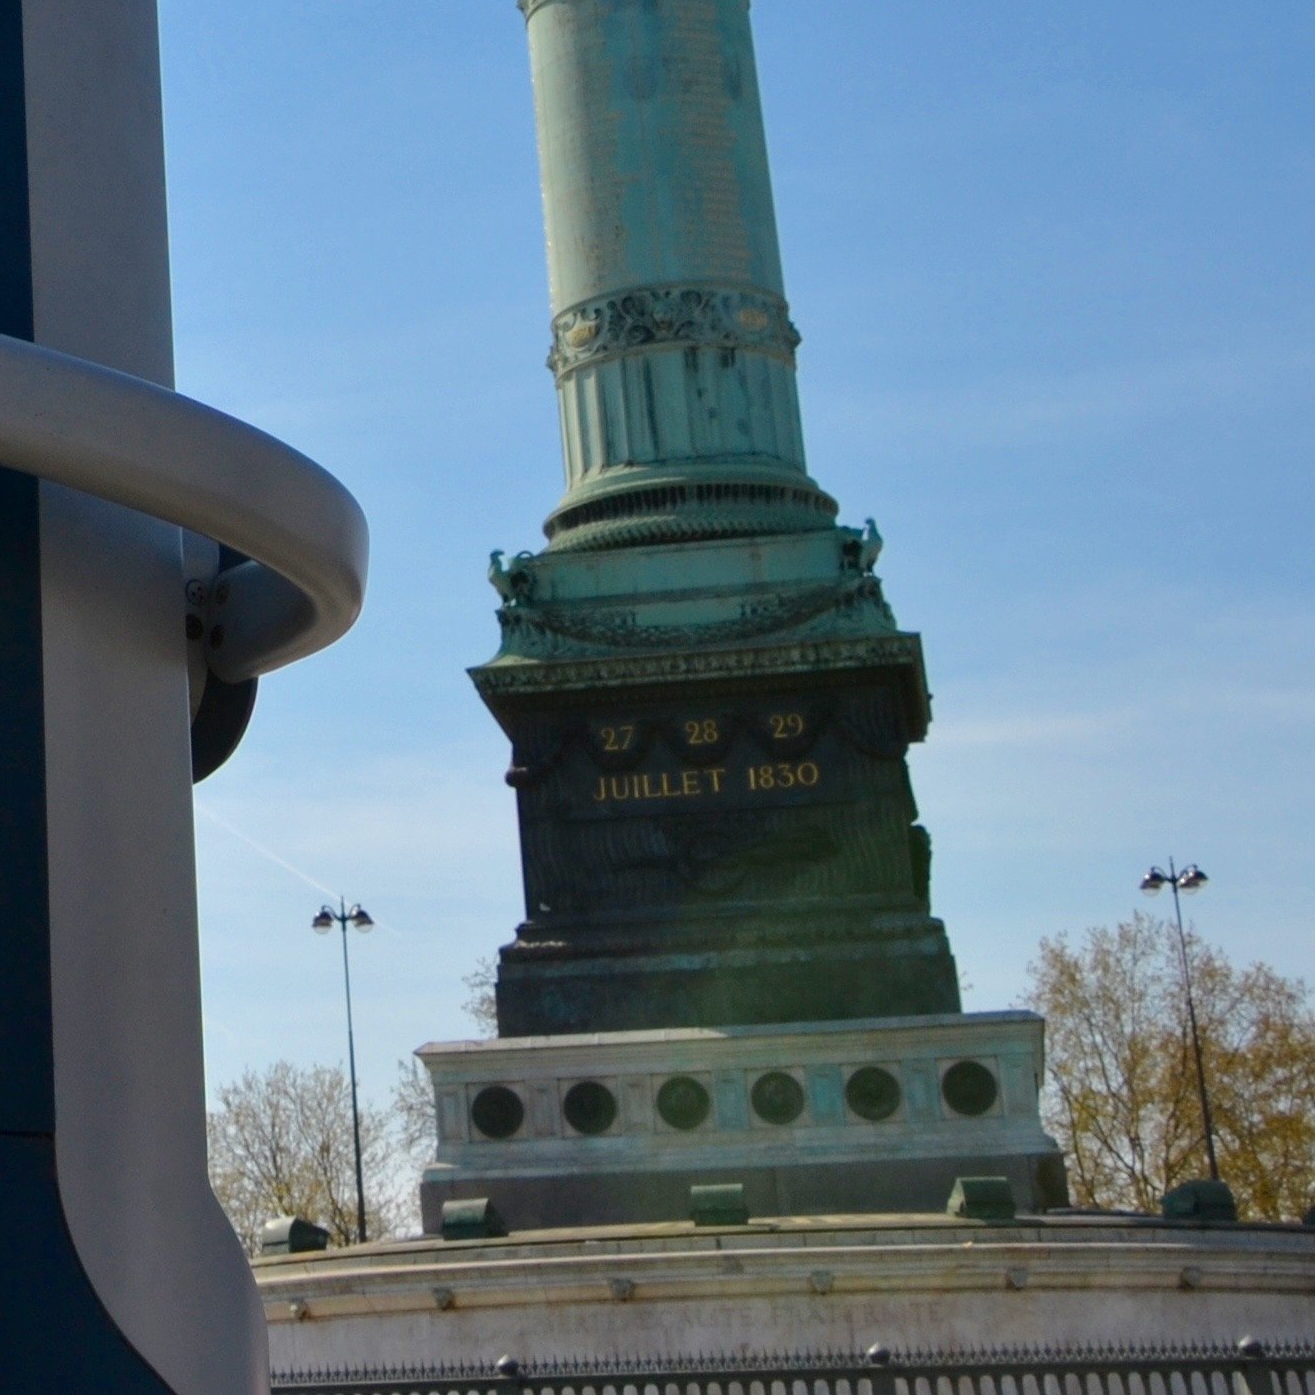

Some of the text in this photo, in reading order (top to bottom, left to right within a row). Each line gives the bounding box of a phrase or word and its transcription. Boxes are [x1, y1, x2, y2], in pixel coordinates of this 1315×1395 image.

[601, 712, 804, 751] 27 28 29
[593, 762, 819, 801] JUILLET 1830
